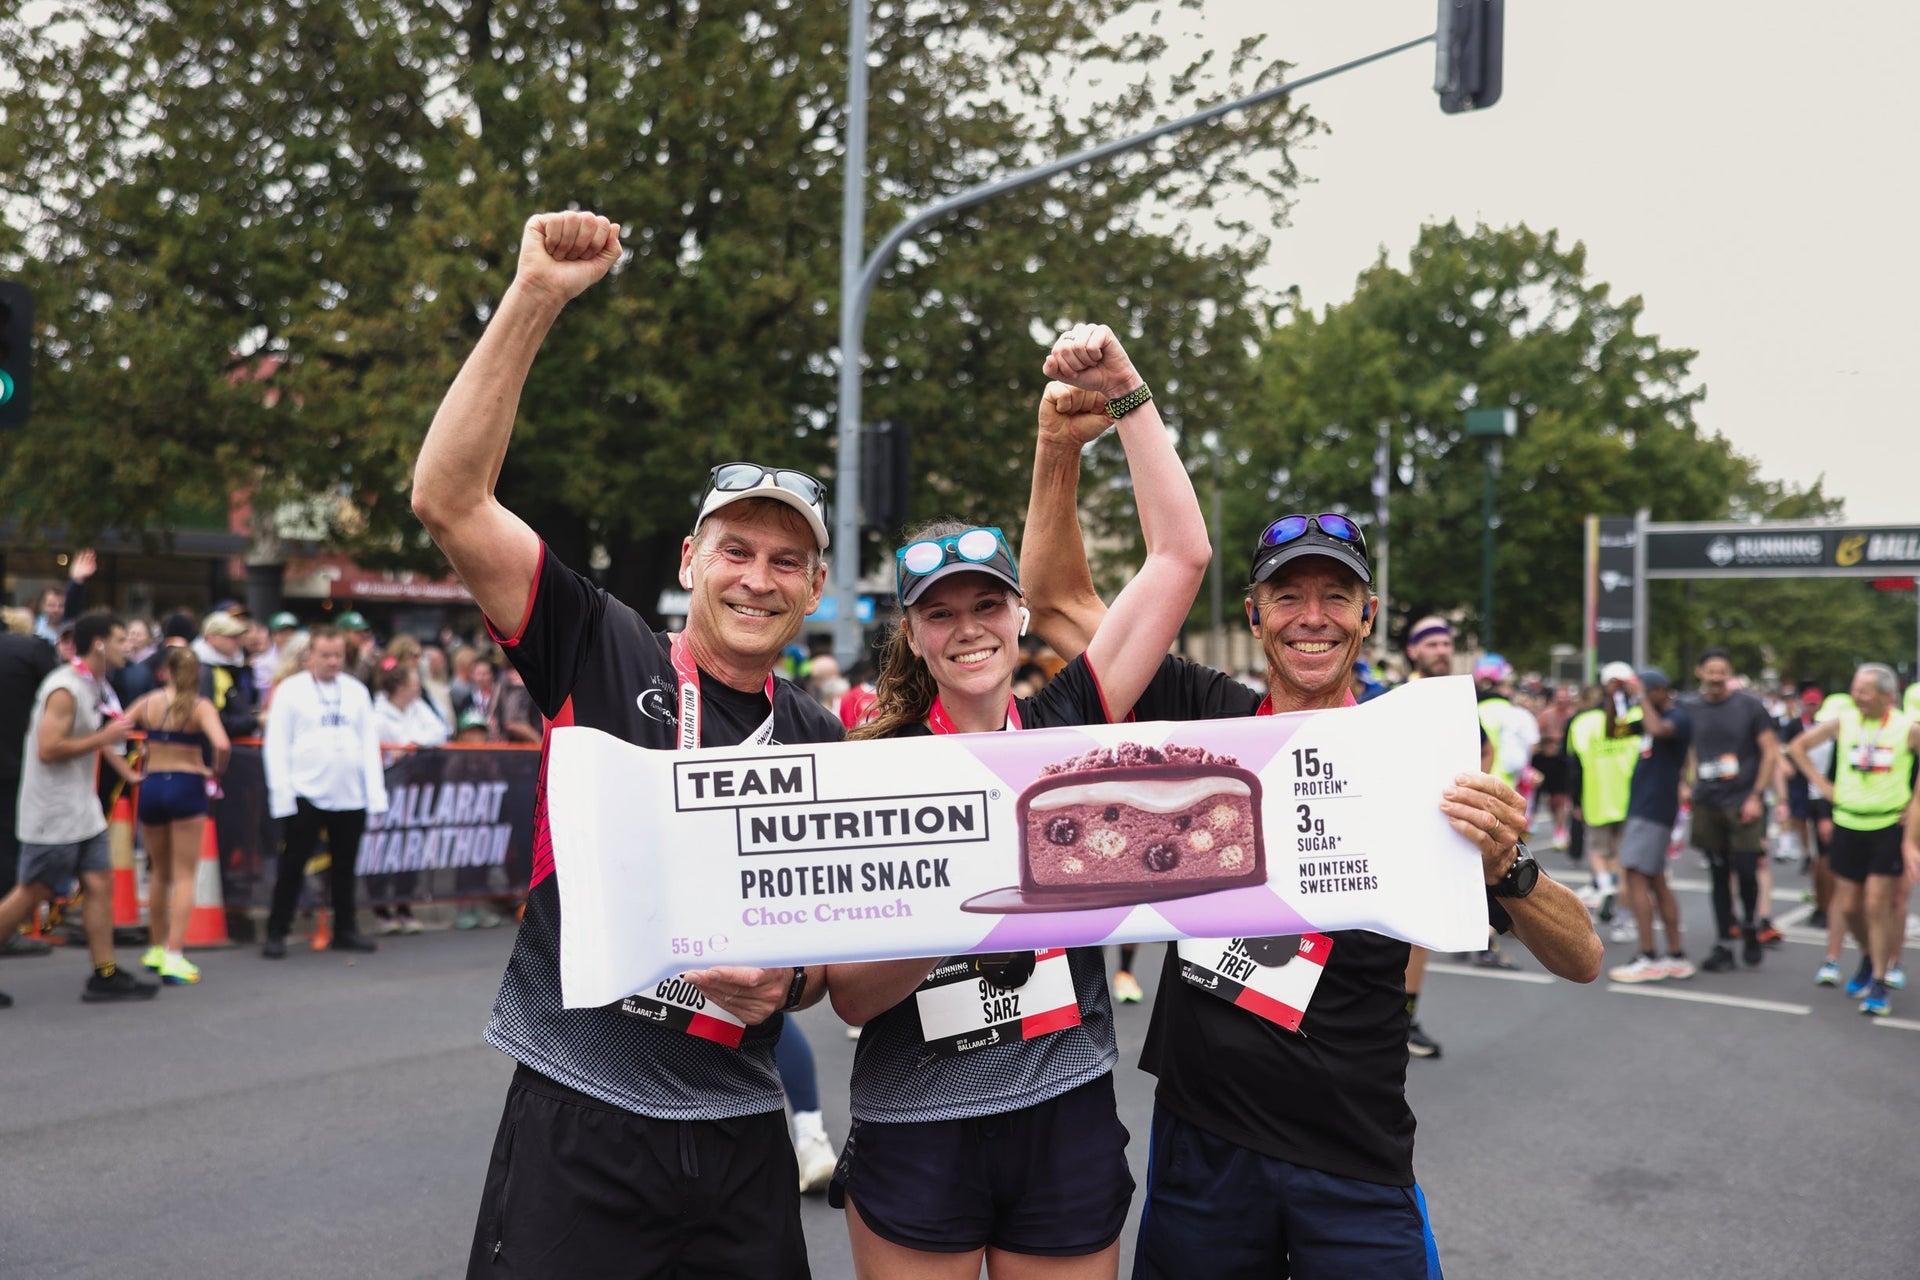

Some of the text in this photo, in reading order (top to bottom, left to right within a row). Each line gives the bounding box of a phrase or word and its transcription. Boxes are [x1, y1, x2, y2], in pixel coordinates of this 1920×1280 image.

[1735, 534, 1823, 556] RUNNING
[1866, 533, 1920, 560] BALL
[684, 688, 695, 750] ALLARAT 10KM
[1292, 748, 1333, 780] 15g
[688, 766, 803, 799] TEAM
[751, 804, 974, 844] NUTRITION
[1296, 804, 1325, 836] 3g
[353, 822, 514, 877] MARATHON
[741, 858, 951, 899] PROTEIN SNACK
[1299, 859, 1369, 877] NO INTENSE
[1300, 875, 1378, 895] SWEETENERS
[741, 899, 913, 927] Choc Crunch
[935, 961, 969, 976] RUNNING
[1216, 951, 1258, 982] TREV
[656, 977, 706, 1010] GOUDS
[621, 1003, 653, 1018] BALLARAT
[983, 994, 1022, 1024] SARZ
[957, 1039, 987, 1052] BALLARAT
